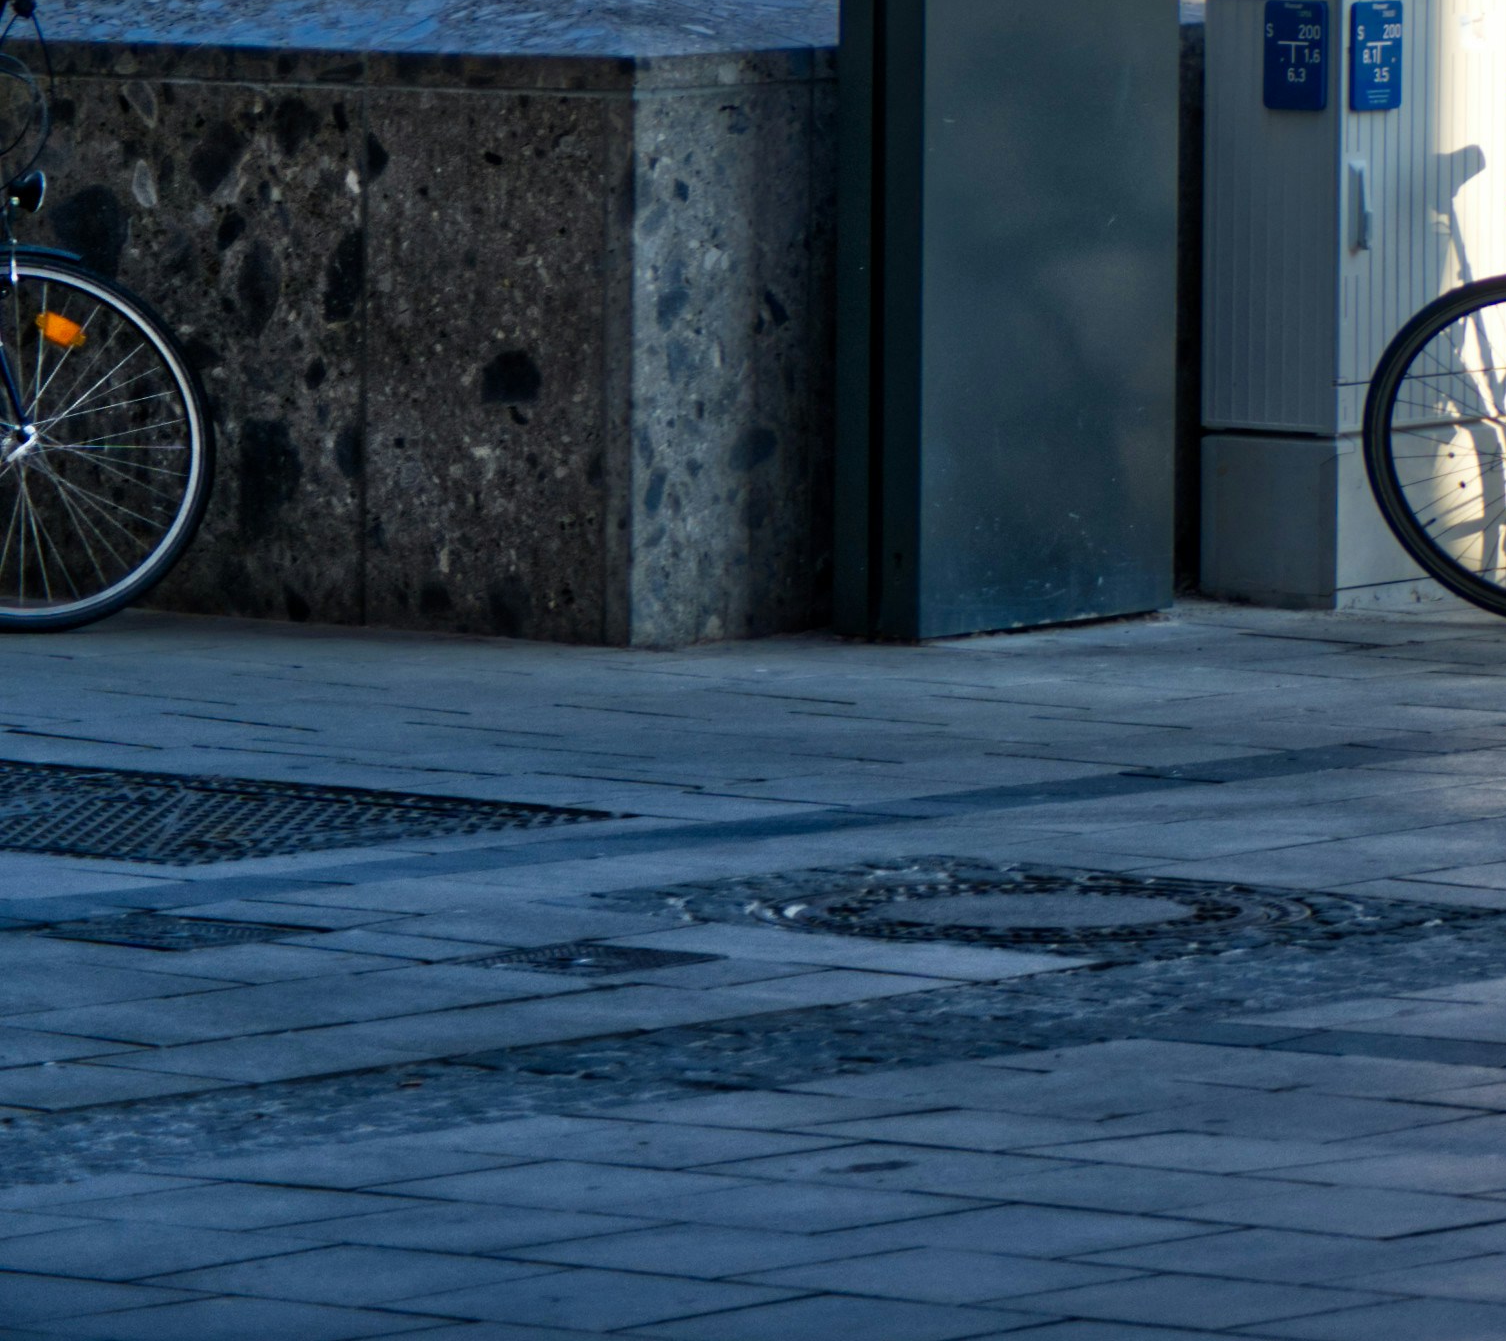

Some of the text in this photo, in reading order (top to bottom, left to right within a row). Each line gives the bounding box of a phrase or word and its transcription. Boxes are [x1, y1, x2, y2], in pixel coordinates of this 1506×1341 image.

[1266, 22, 1321, 40] S 200
[1357, 23, 1402, 41] S 200
